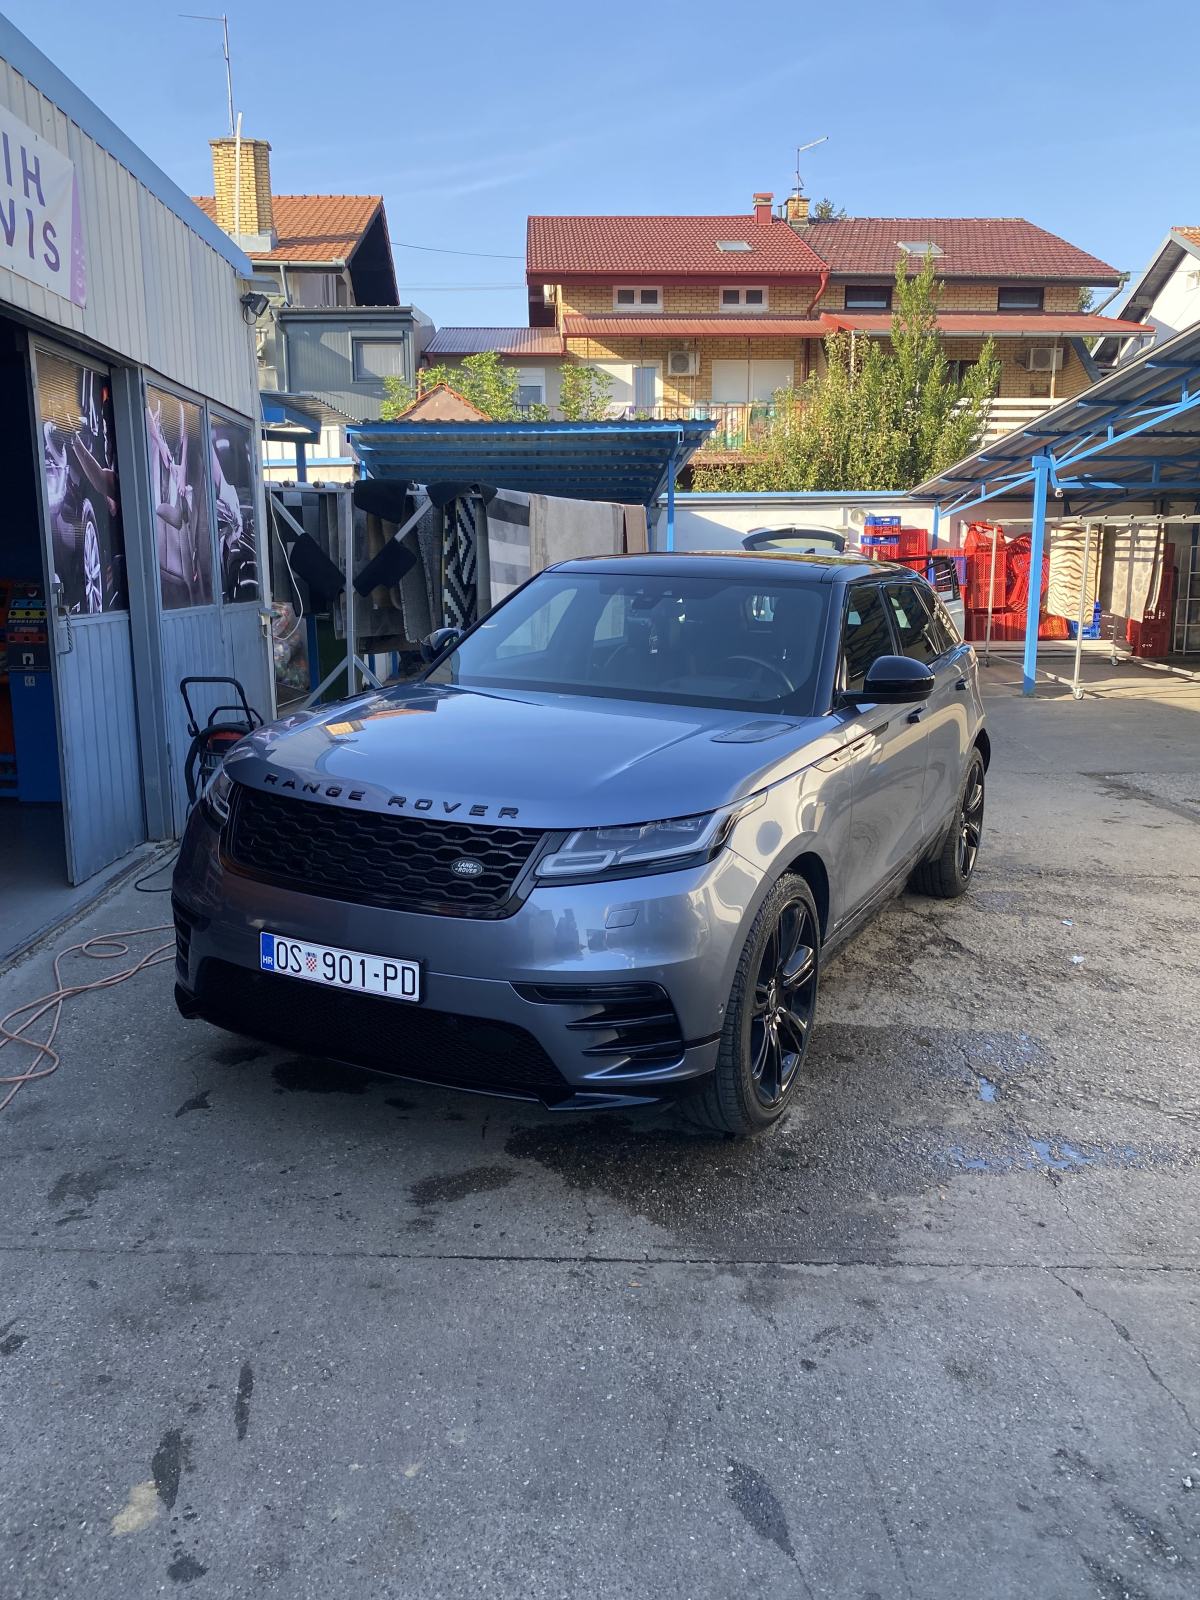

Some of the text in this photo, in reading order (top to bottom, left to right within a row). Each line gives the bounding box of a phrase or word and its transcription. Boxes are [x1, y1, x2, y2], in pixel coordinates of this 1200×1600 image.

[263, 773, 519, 819] RANGE ROVER
[262, 955, 273, 966] HR
[276, 941, 416, 996] OS 901-PD
